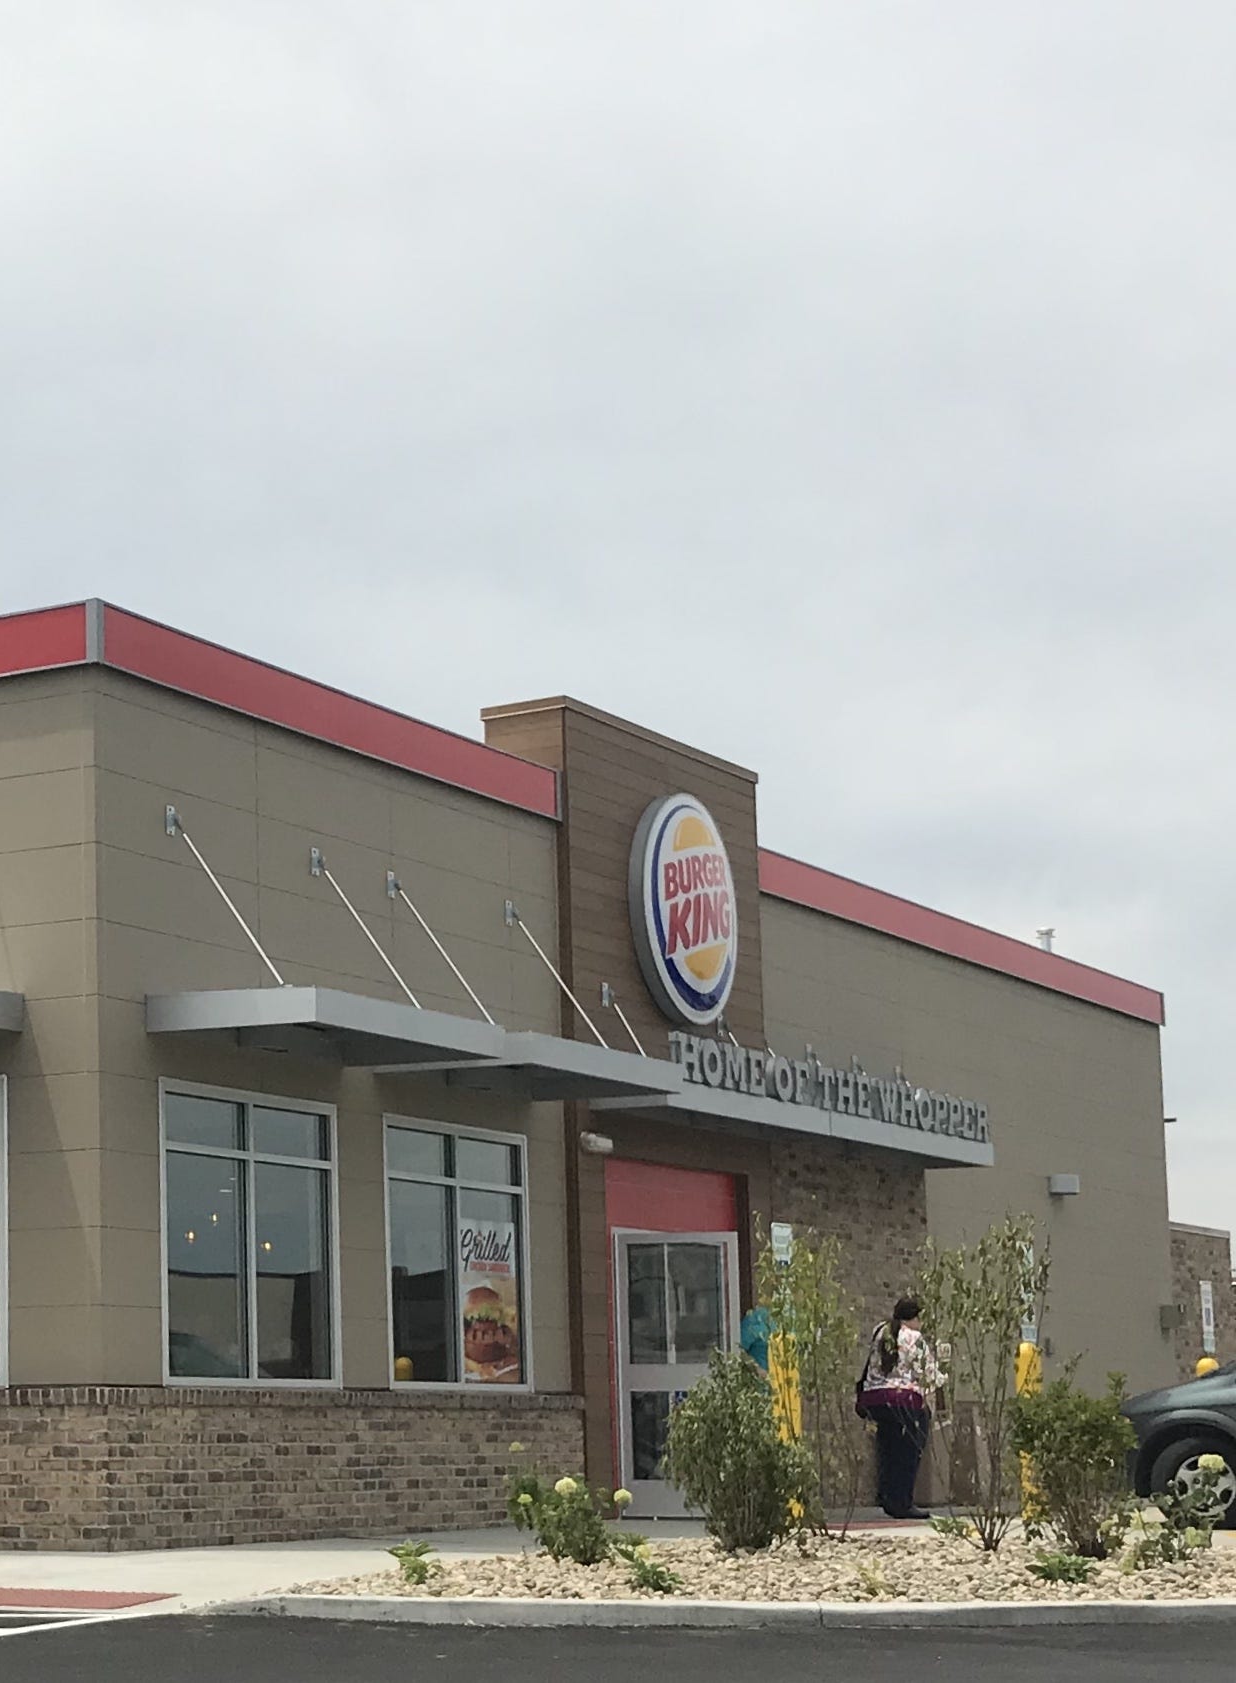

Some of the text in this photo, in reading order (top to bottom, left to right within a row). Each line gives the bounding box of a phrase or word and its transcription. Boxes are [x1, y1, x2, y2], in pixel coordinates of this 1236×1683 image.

[665, 854, 726, 900] BURGER
[667, 890, 731, 955] KING
[672, 1032, 990, 1143] HOME OF THE WHOPPER
[460, 1228, 512, 1273] Grilled
